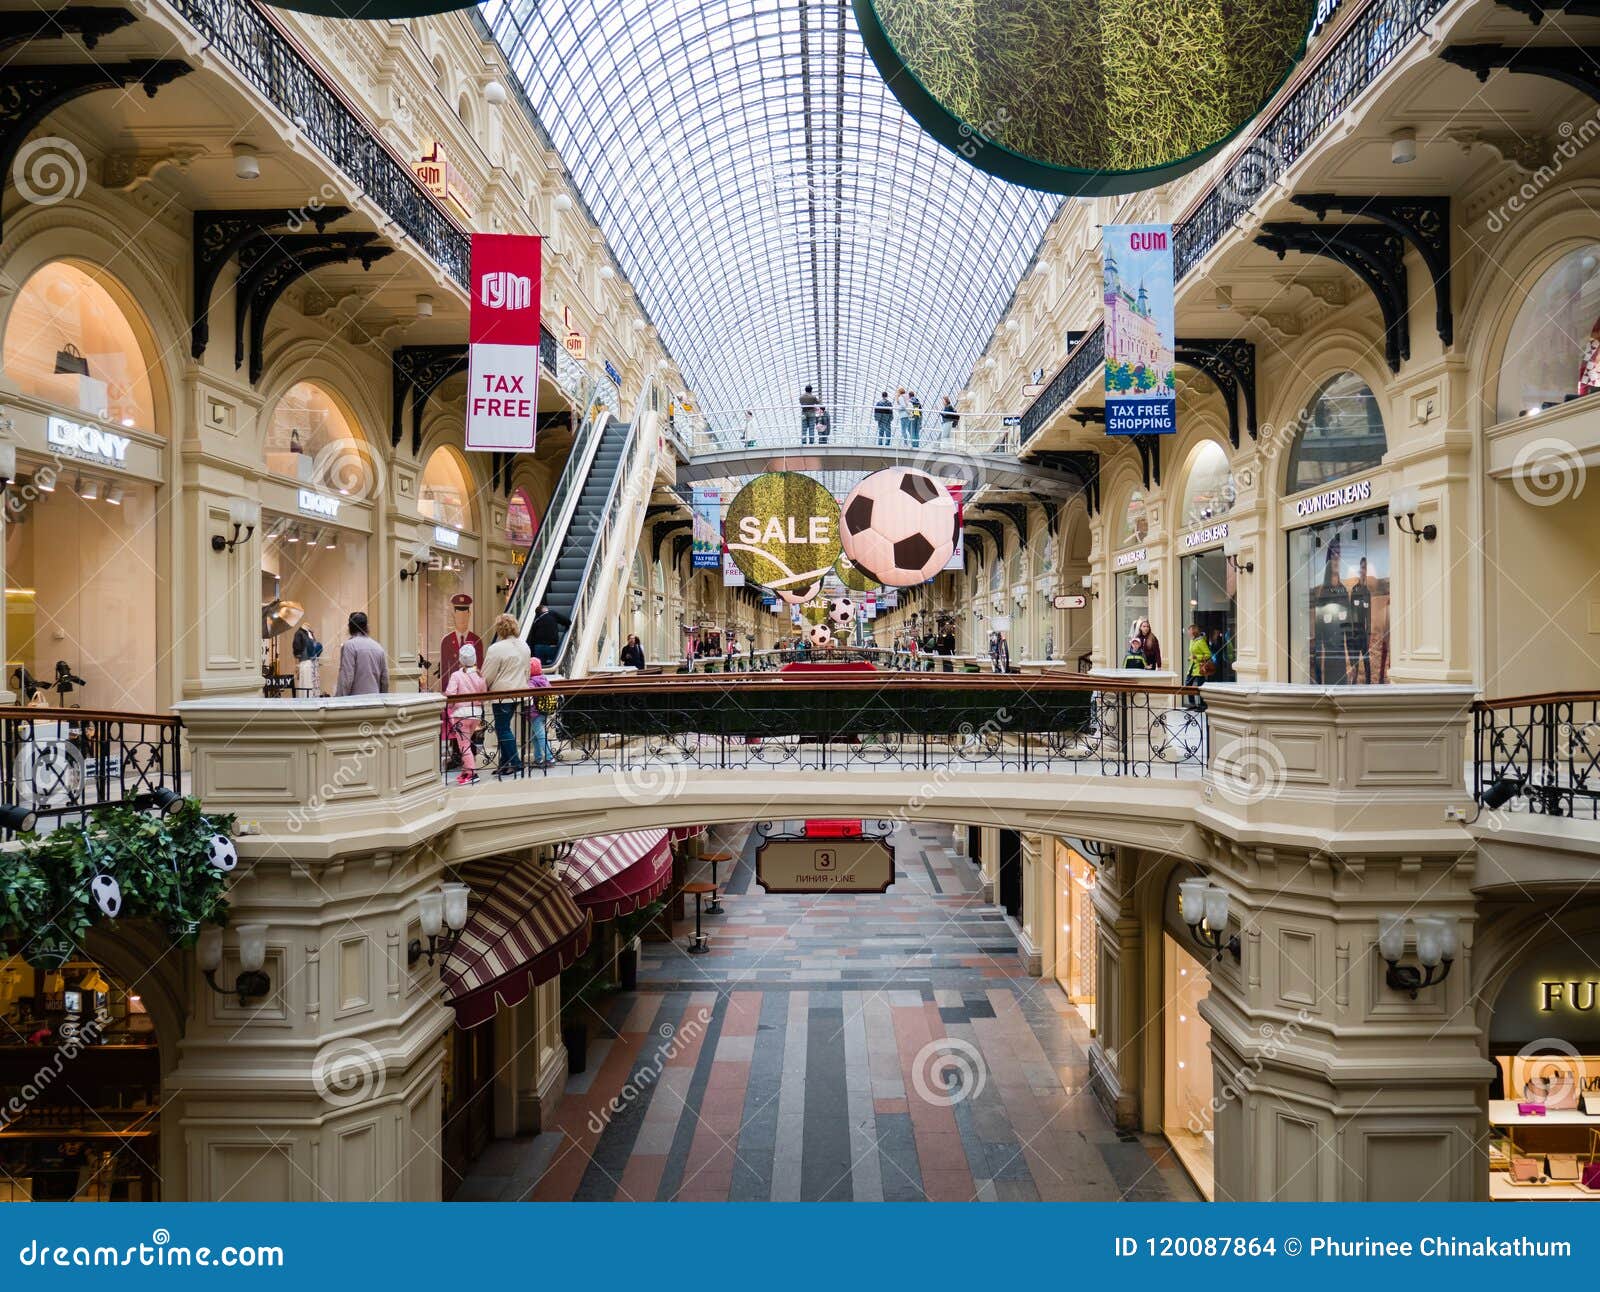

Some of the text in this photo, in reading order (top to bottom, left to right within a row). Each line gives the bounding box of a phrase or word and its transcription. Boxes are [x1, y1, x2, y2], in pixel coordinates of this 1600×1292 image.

[1130, 232, 1167, 251] GUM
[483, 374, 524, 394] TAX
[473, 398, 531, 418] FREE
[1111, 404, 1169, 417] TAX FREE
[1109, 417, 1172, 429] SHOPPING
[47, 416, 131, 461] DKNY
[1297, 481, 1371, 517] CALVIN KLEIN JEANS
[739, 516, 831, 544] SALE
[821, 853, 830, 867] 3
[835, 874, 857, 883] LINE
[28, 941, 69, 954] SALE
